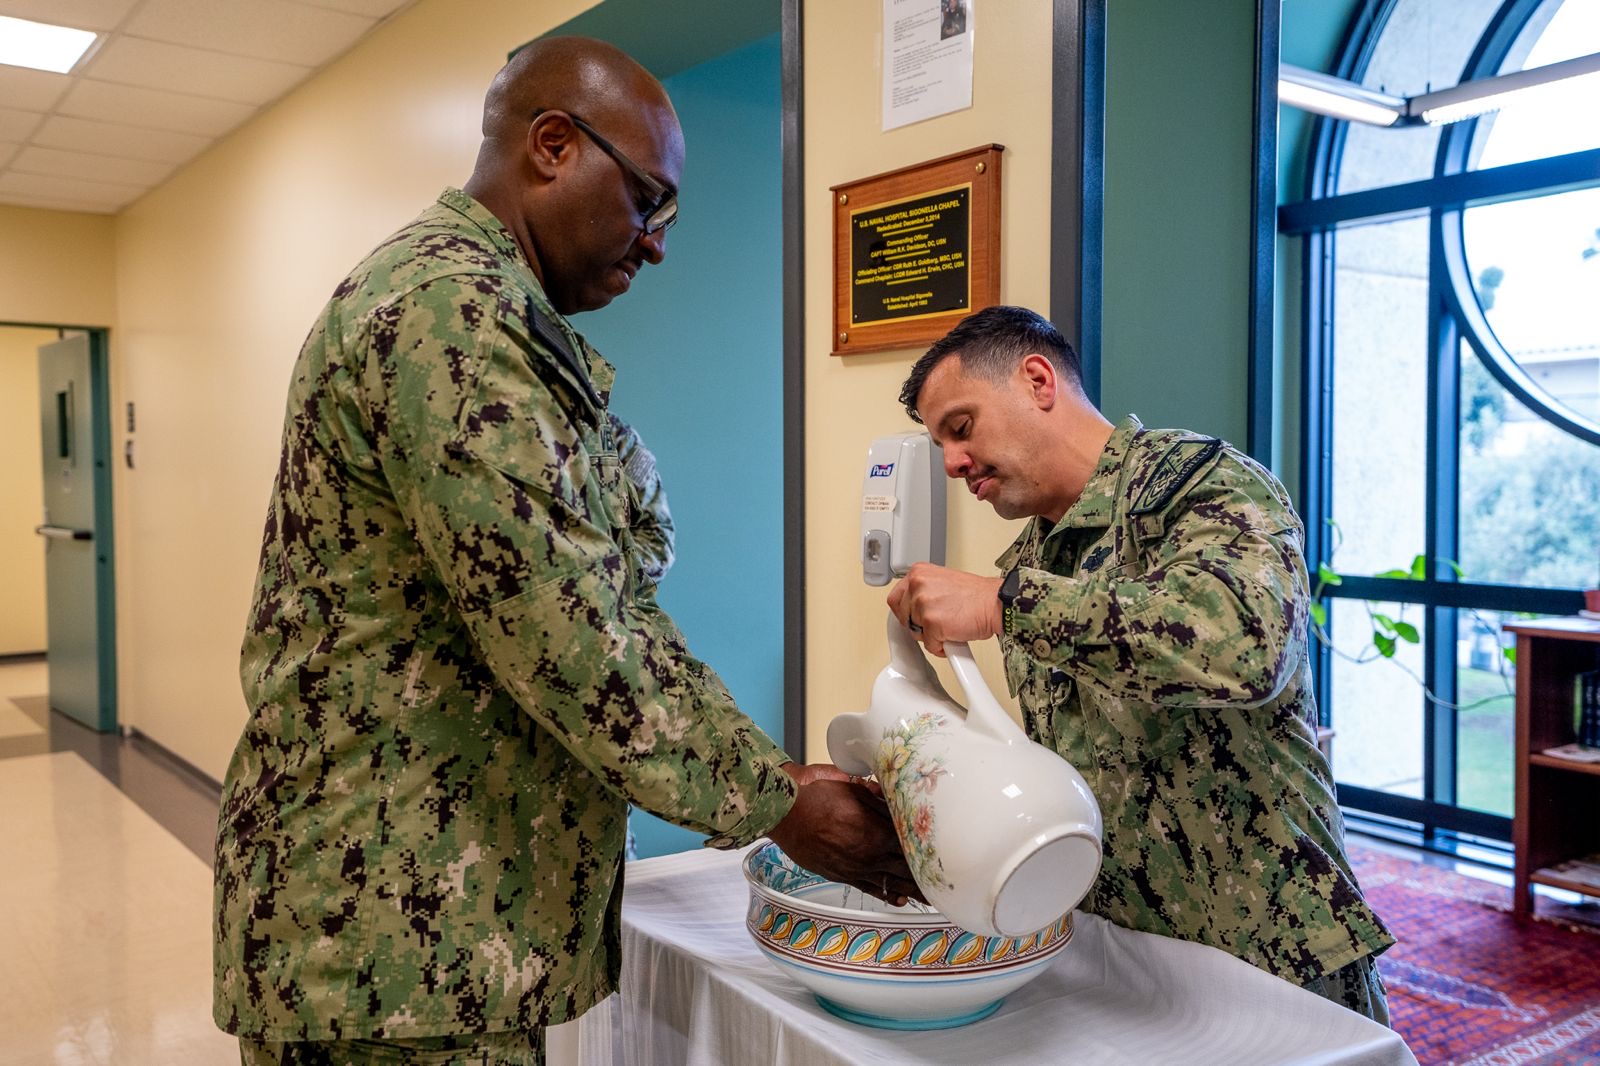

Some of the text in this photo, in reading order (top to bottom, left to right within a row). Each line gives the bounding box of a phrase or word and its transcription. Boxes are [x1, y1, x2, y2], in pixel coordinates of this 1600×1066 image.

[884, 212, 909, 222] HOSPITAL
[909, 205, 938, 216] SIGONELLA
[938, 200, 960, 210] CHAPEL
[886, 236, 913, 247] Commanding
[936, 238, 946, 246] USN
